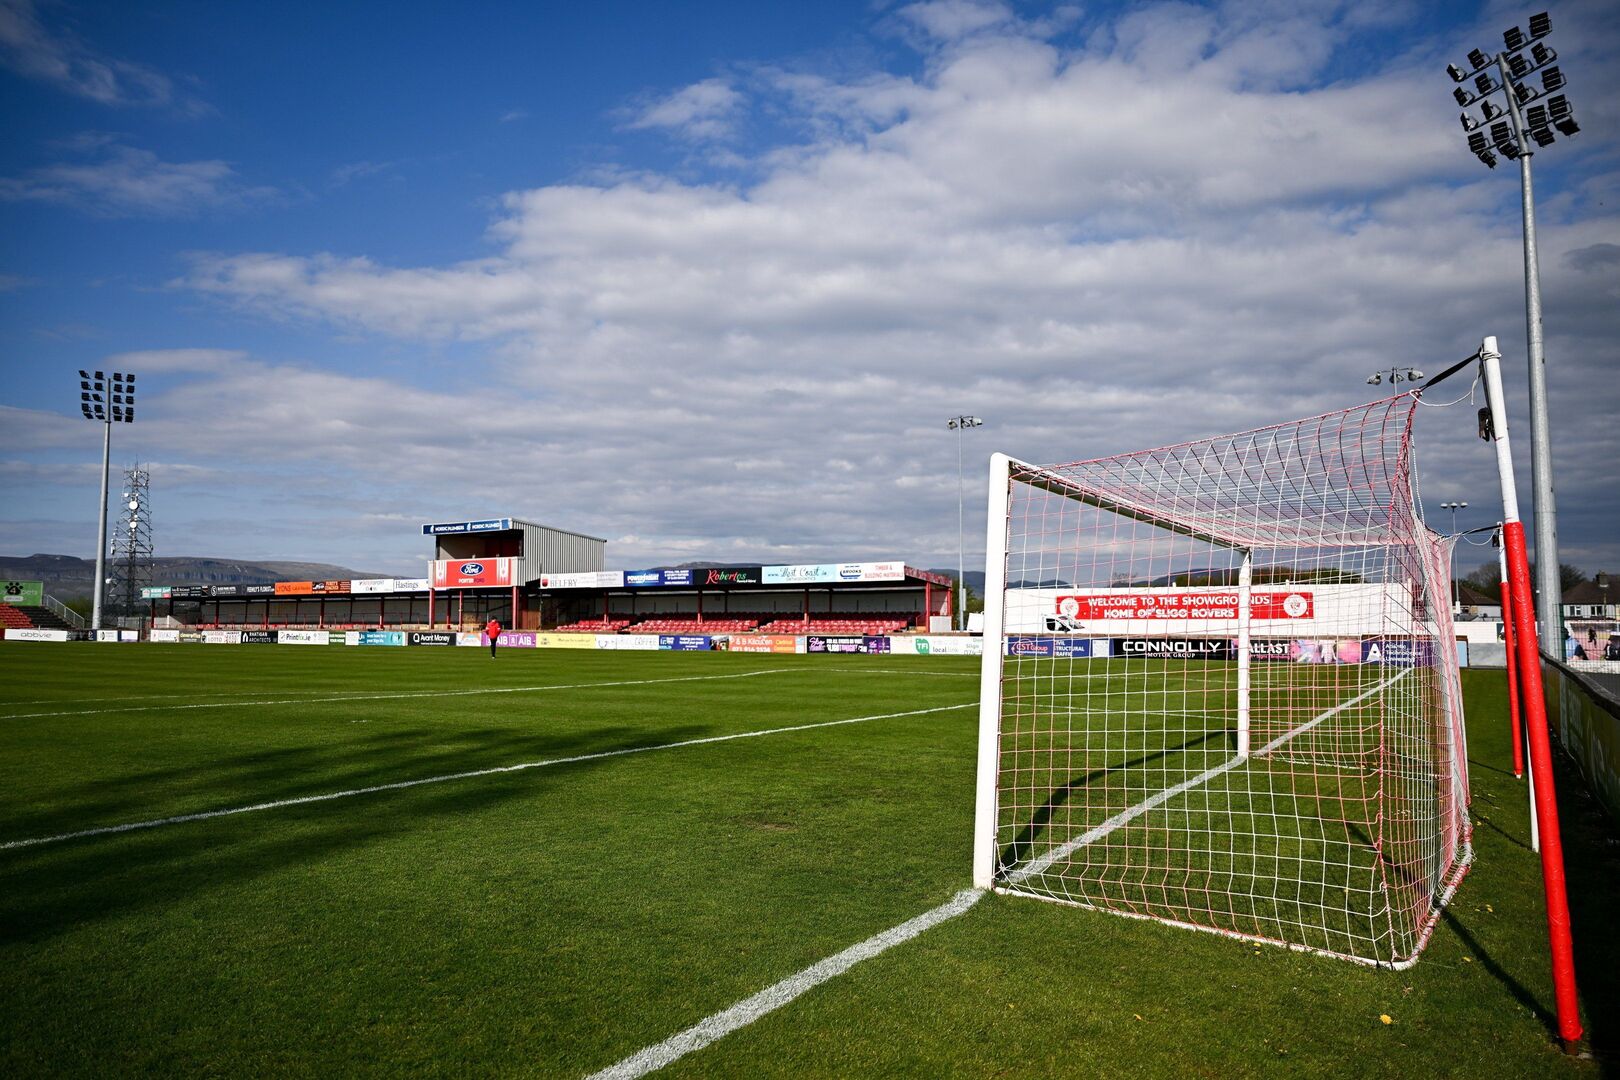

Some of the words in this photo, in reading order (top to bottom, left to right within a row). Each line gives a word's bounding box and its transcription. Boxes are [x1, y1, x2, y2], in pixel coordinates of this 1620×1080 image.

[464, 564, 480, 574] Ford
[395, 580, 419, 590] Hastings
[550, 579, 578, 588] BELFRY
[1088, 597, 1137, 606] WELCOME
[1141, 597, 1155, 606] TO
[1158, 596, 1178, 605] THE
[1104, 609, 1134, 618] HOME
[1137, 609, 1151, 618] OF
[1155, 608, 1188, 618] SLIGO
[1191, 608, 1235, 618] ROVERS
[420, 634, 434, 642] Avant
[434, 633, 450, 643] Money
[518, 636, 532, 646] AIB
[1016, 643, 1031, 651] CST
[1122, 641, 1221, 653] CONNOLLY
